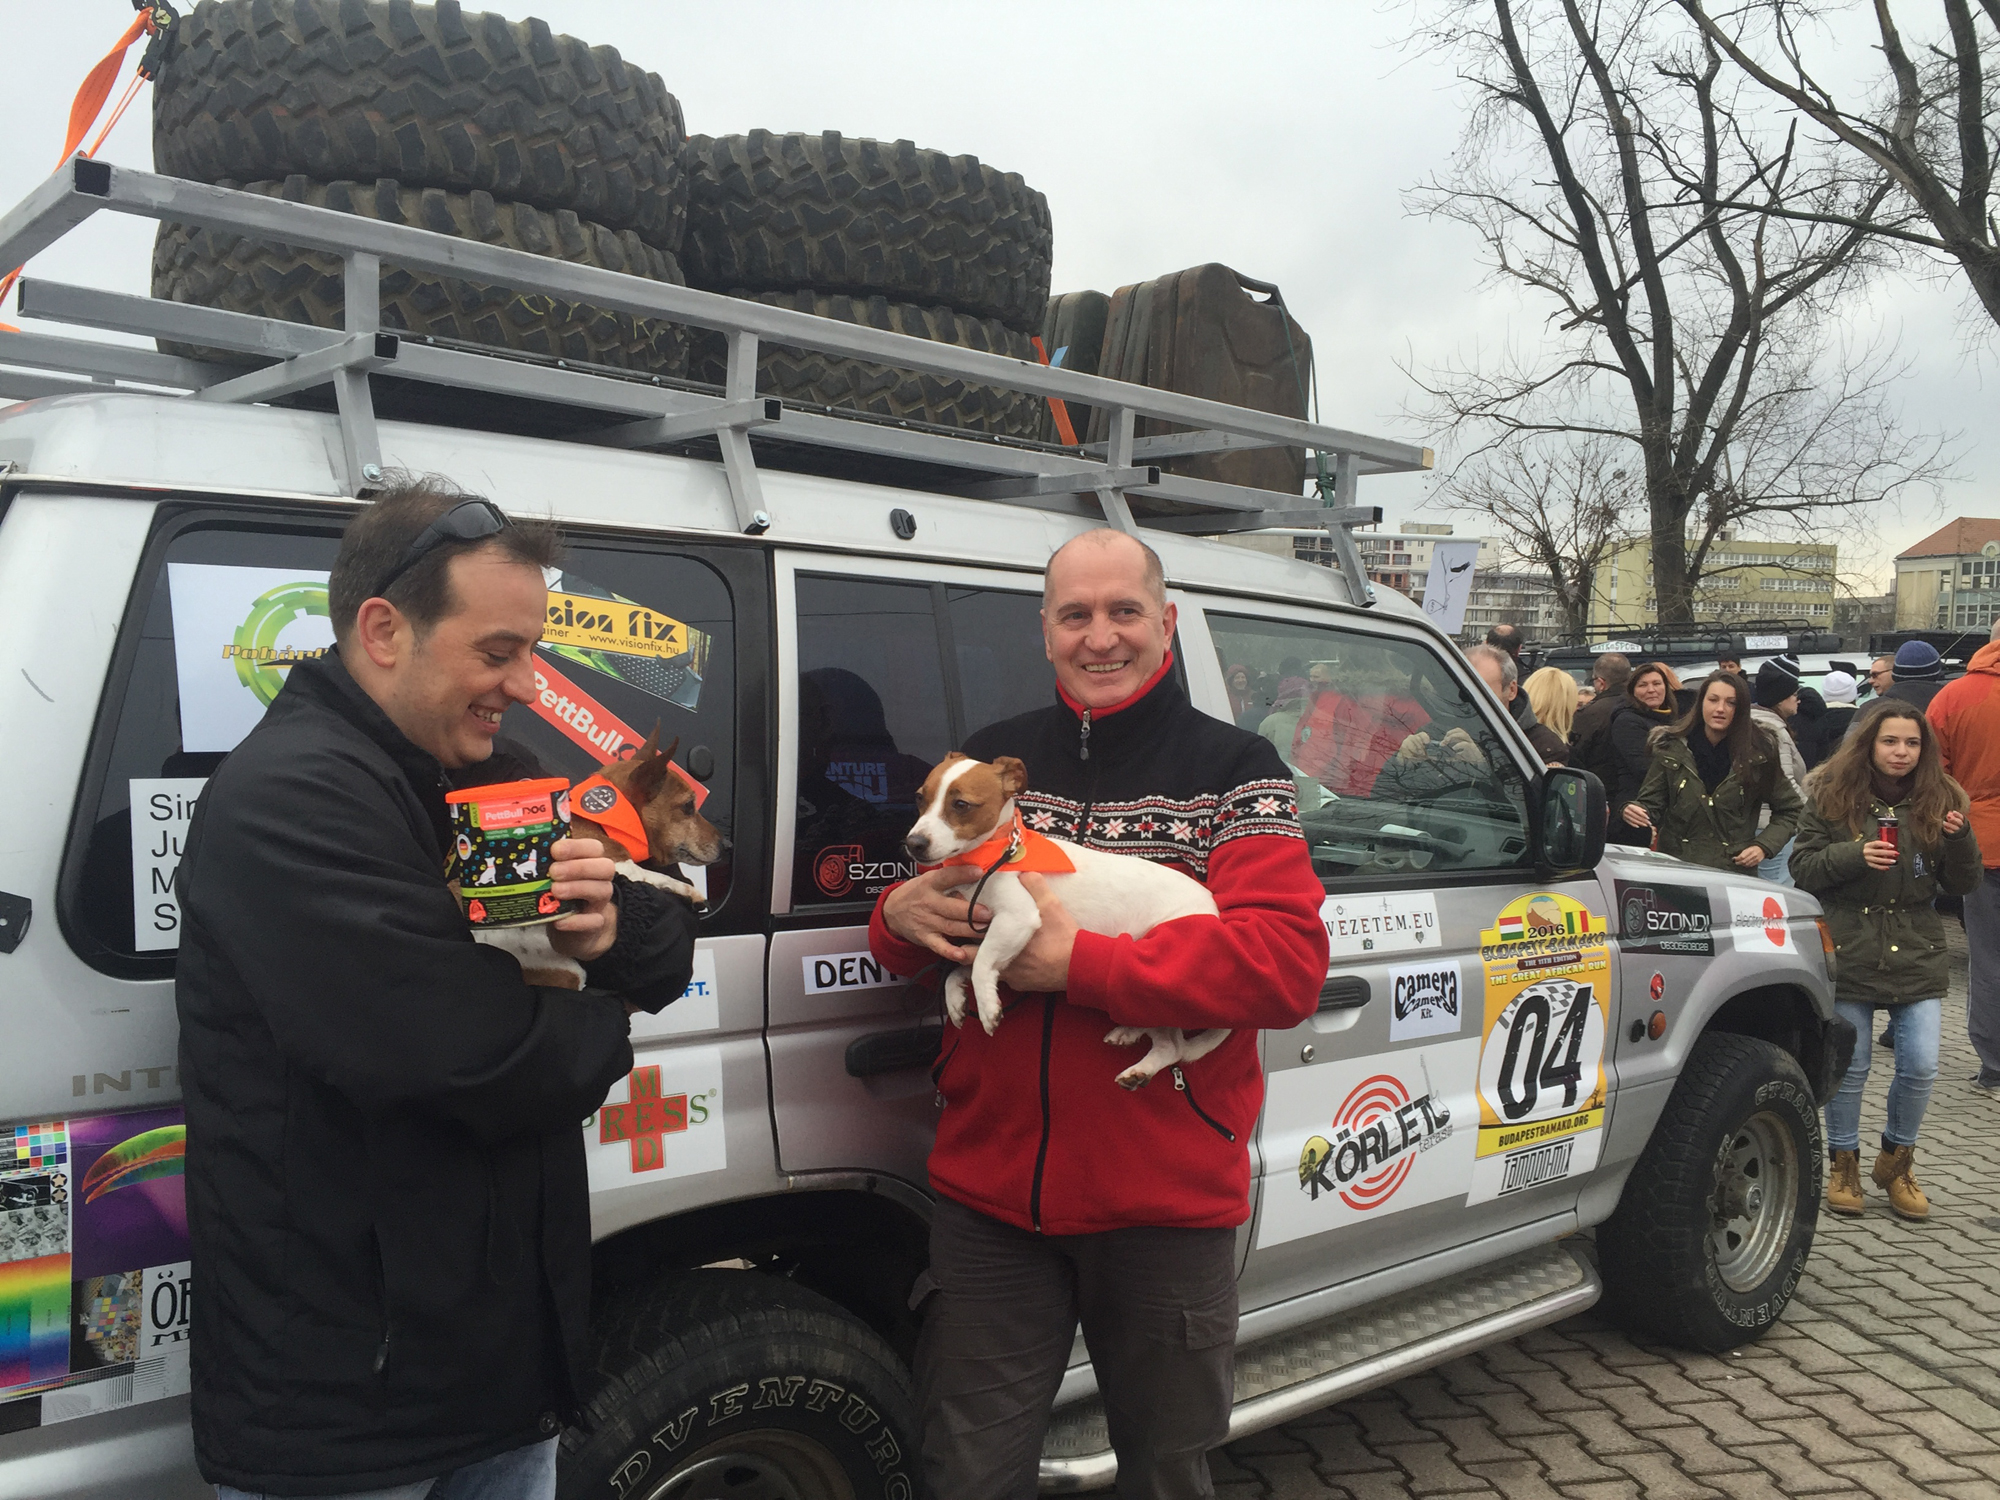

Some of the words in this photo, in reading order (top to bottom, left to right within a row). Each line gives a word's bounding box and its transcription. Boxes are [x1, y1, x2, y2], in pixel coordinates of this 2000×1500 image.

[629, 610, 678, 643] fix
[589, 634, 680, 655] www.visionfix.hu
[827, 762, 887, 776] NTURE
[1527, 924, 1565, 939] 2016
[1646, 910, 1710, 932] SZONDI
[814, 958, 899, 989] DEN
[1489, 974, 1508, 987] THE
[1511, 968, 1541, 983] GREAT
[1544, 963, 1585, 979] AFRICAN
[1588, 959, 1607, 972] RUN
[1524, 958, 1536, 968] THE
[1553, 953, 1577, 964] EDITION
[1394, 970, 1458, 1021] Camera
[1497, 986, 1593, 1120] 04
[72, 1065, 181, 1097] INT
[1498, 1113, 1590, 1148] BUDAPESTBAMAKO.ORG
